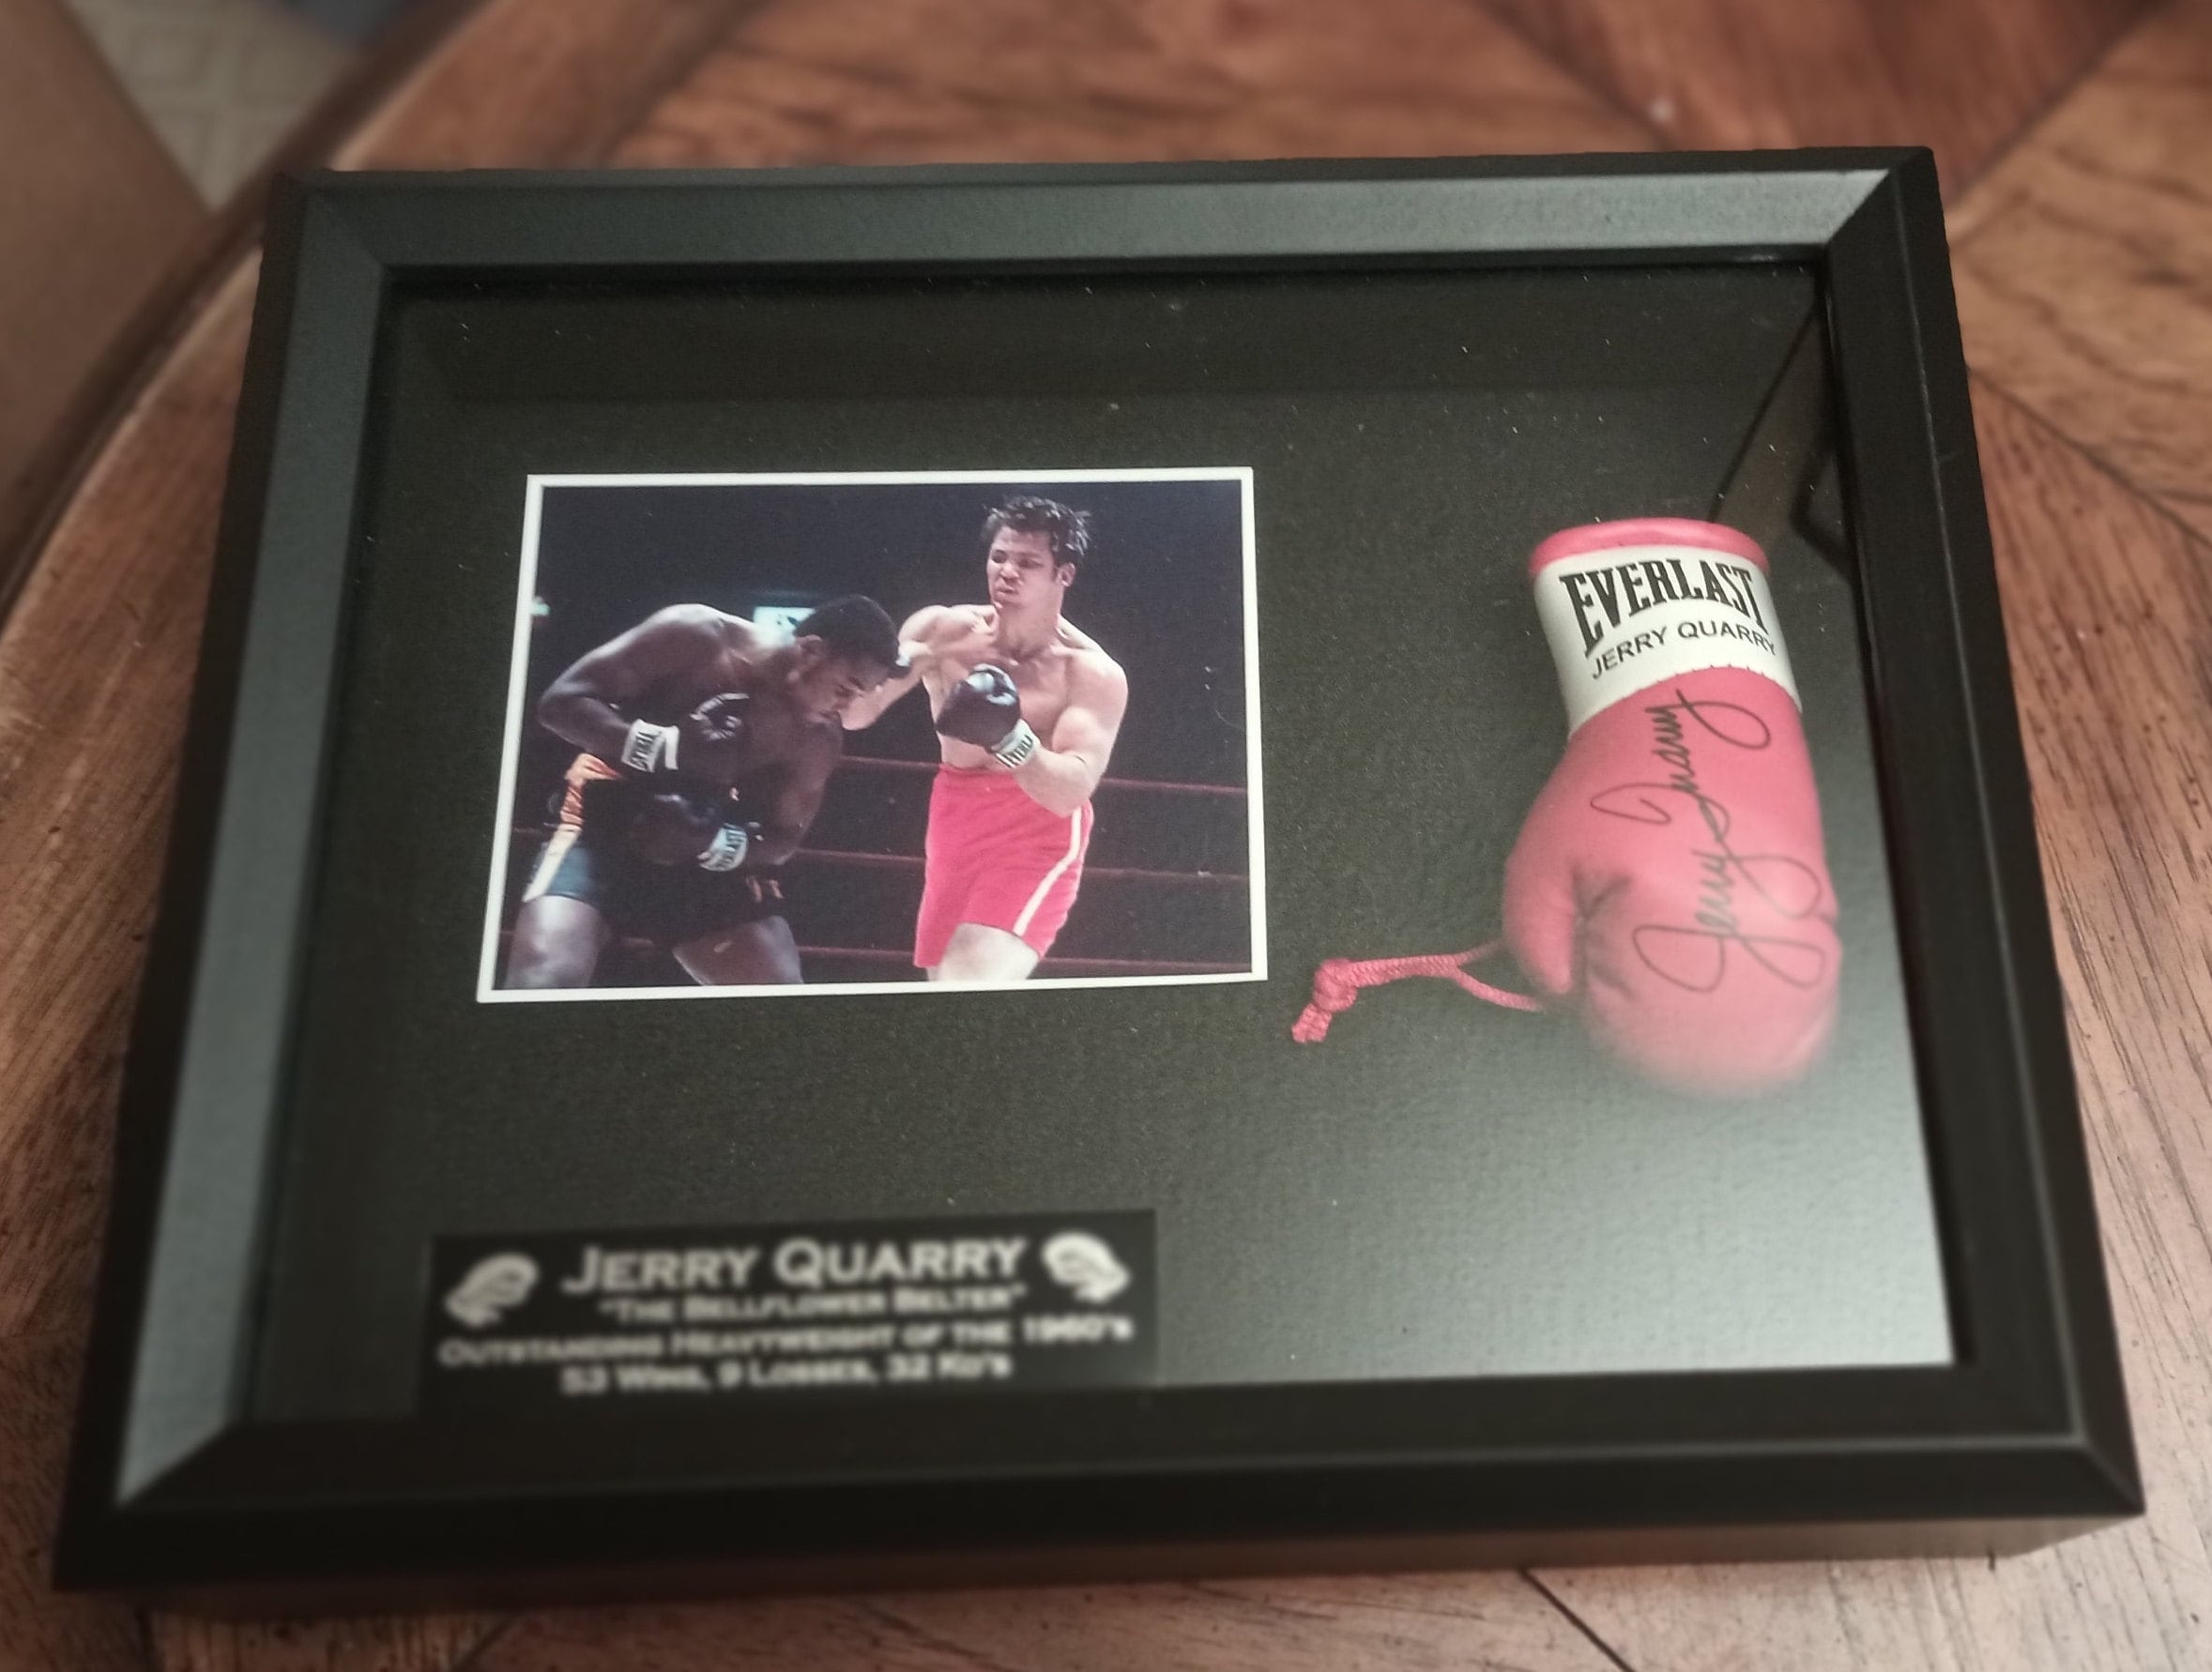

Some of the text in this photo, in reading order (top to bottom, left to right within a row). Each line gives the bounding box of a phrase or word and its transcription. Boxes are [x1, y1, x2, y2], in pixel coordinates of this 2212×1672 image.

[1559, 557, 1769, 659] EVERLAST
[1592, 618, 1777, 679] JERRY QUARRY
[561, 1238, 1029, 1294] JERRY QUARRY
